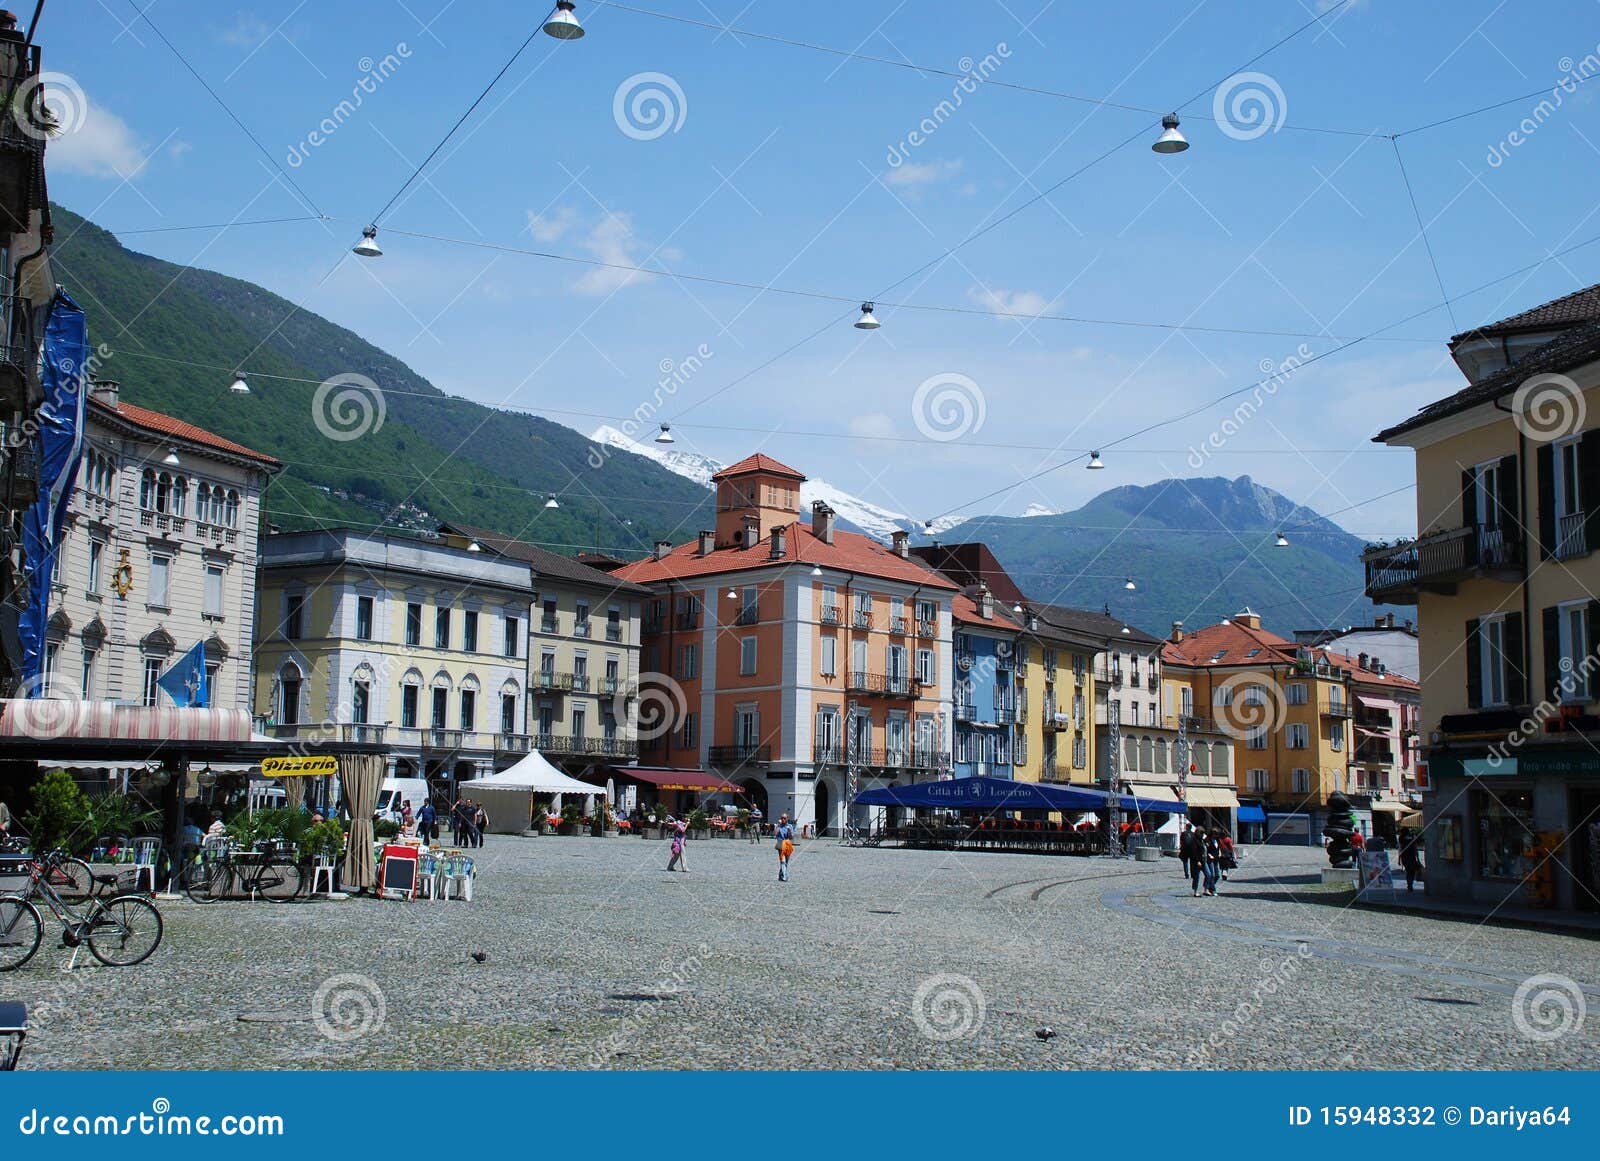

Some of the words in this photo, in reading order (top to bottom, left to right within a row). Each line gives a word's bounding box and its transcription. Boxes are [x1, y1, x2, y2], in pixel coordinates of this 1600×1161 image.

[264, 758, 336, 772] Pizzeria
[953, 785, 964, 796] di
[990, 786, 1032, 797] Locarno
